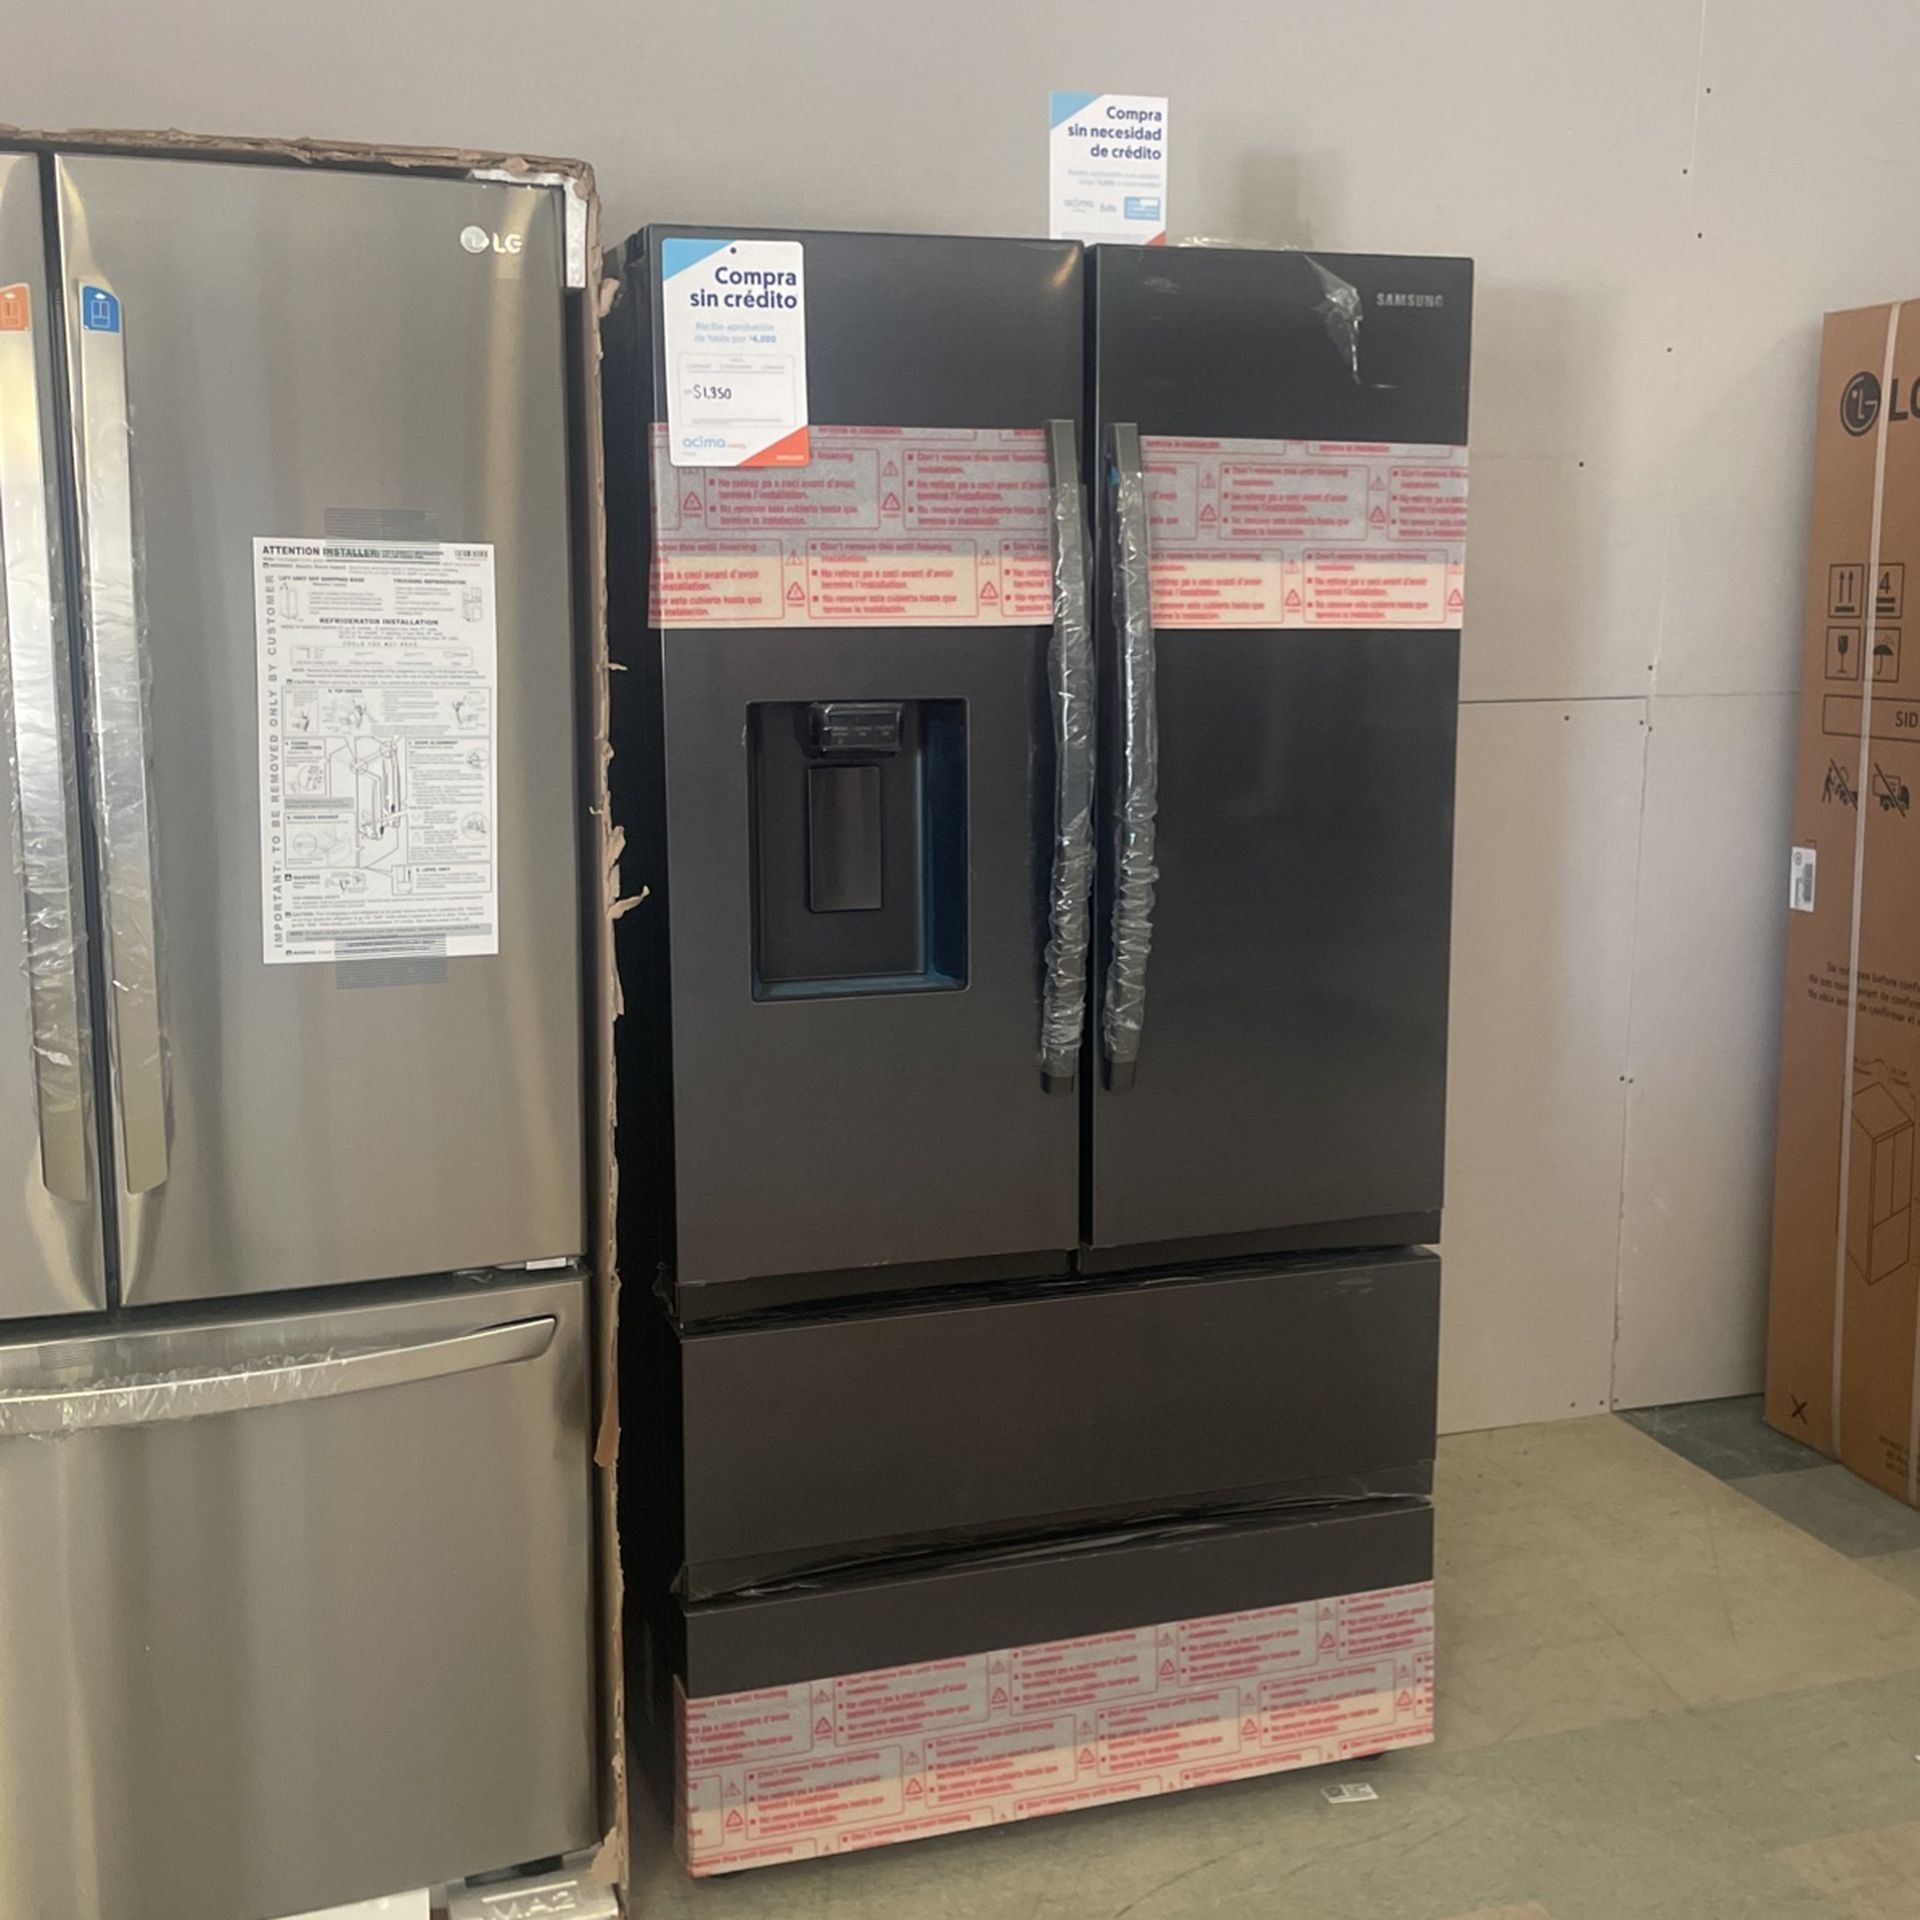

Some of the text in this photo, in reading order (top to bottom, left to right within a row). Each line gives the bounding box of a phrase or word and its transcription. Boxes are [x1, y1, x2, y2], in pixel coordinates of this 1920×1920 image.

[1106, 106, 1162, 123] Compra
[1068, 124, 1162, 141] sin necesidad
[1090, 144, 1162, 160] de crédito
[492, 232, 523, 254] LG
[715, 266, 797, 289] Compra
[690, 289, 797, 309] sin crédito
[1376, 293, 1444, 308] SAMSUNG
[682, 435, 726, 448] acima
[263, 546, 320, 555] ATTENTION
[1878, 571, 1891, 594] 4
[265, 575, 277, 656] CUSTOMER
[382, 618, 439, 626] INSTALLATION
[268, 663, 278, 682] BY
[269, 690, 279, 727] ONLY
[1895, 711, 1920, 728] SID
[269, 734, 280, 802] REMOVED
[271, 809, 281, 823] BE
[272, 835, 282, 852] TO
